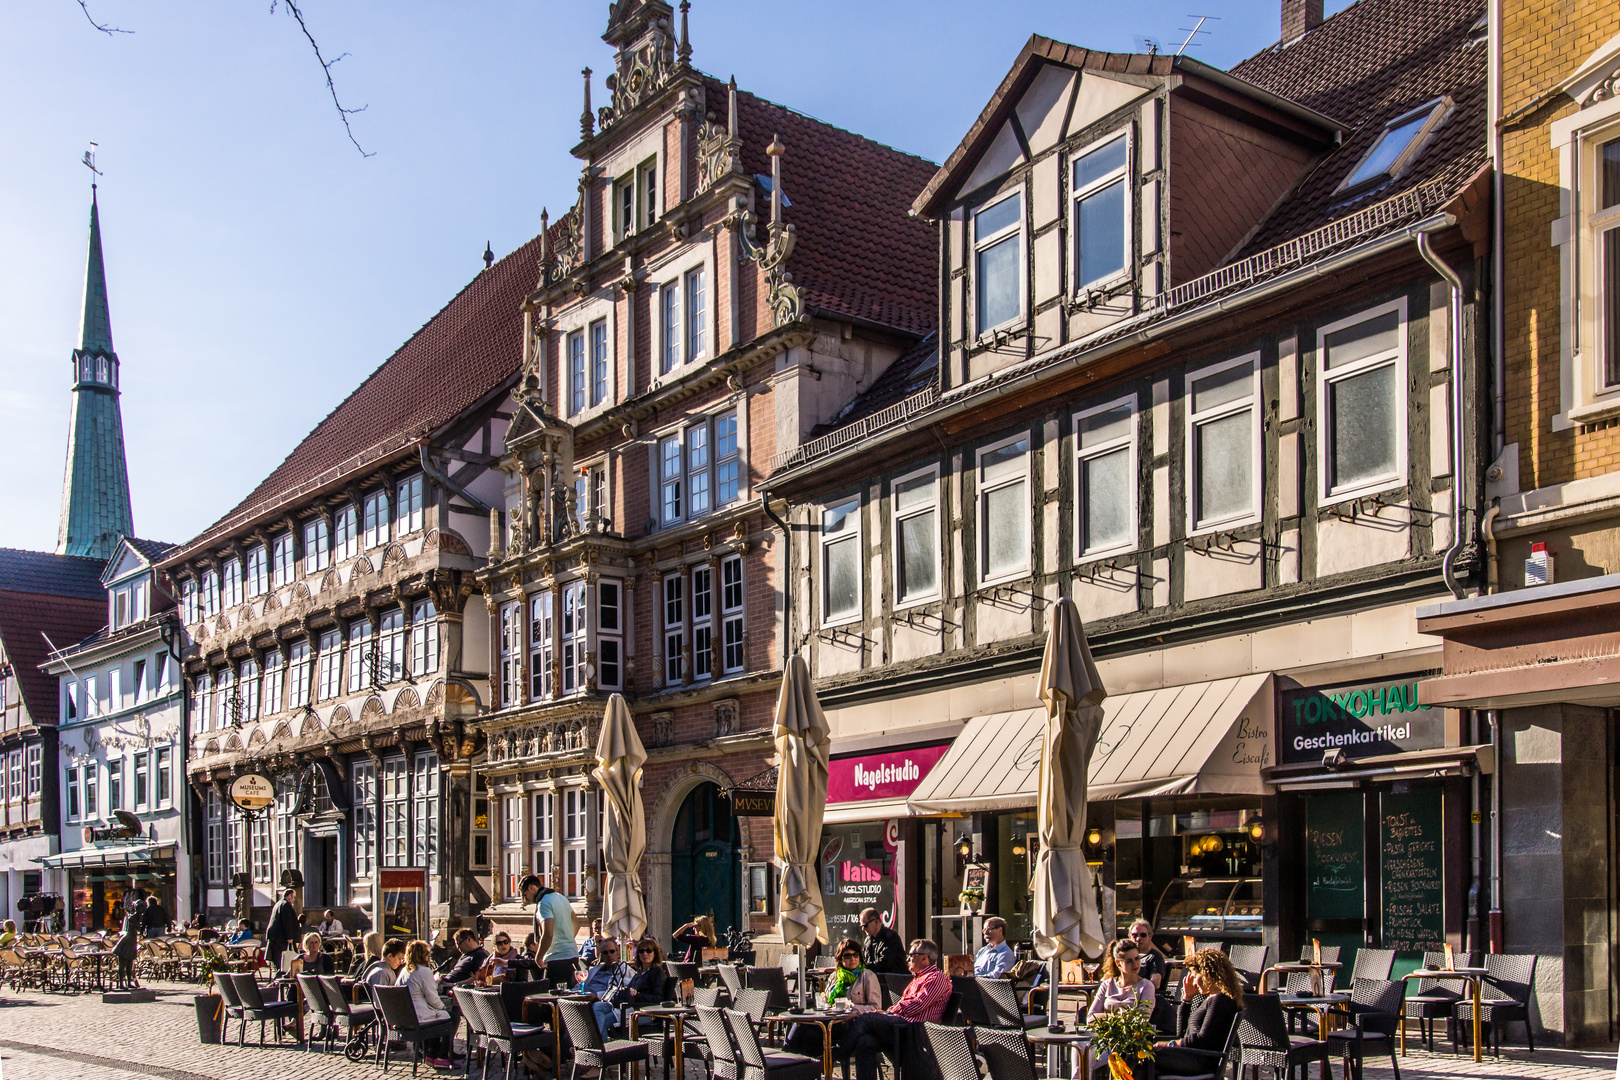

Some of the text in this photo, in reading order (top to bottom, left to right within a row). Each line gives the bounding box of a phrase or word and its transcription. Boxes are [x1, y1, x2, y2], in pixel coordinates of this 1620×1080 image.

[1292, 682, 1432, 725] TOKYOHAU
[1236, 718, 1268, 740] Bistro
[1293, 722, 1411, 751] Geschenkartikel
[1232, 742, 1269, 770] Eiscafé
[854, 759, 920, 791] Nagelstudio
[840, 860, 882, 882] Nails
[839, 885, 882, 894] NAGELSTUDIO
